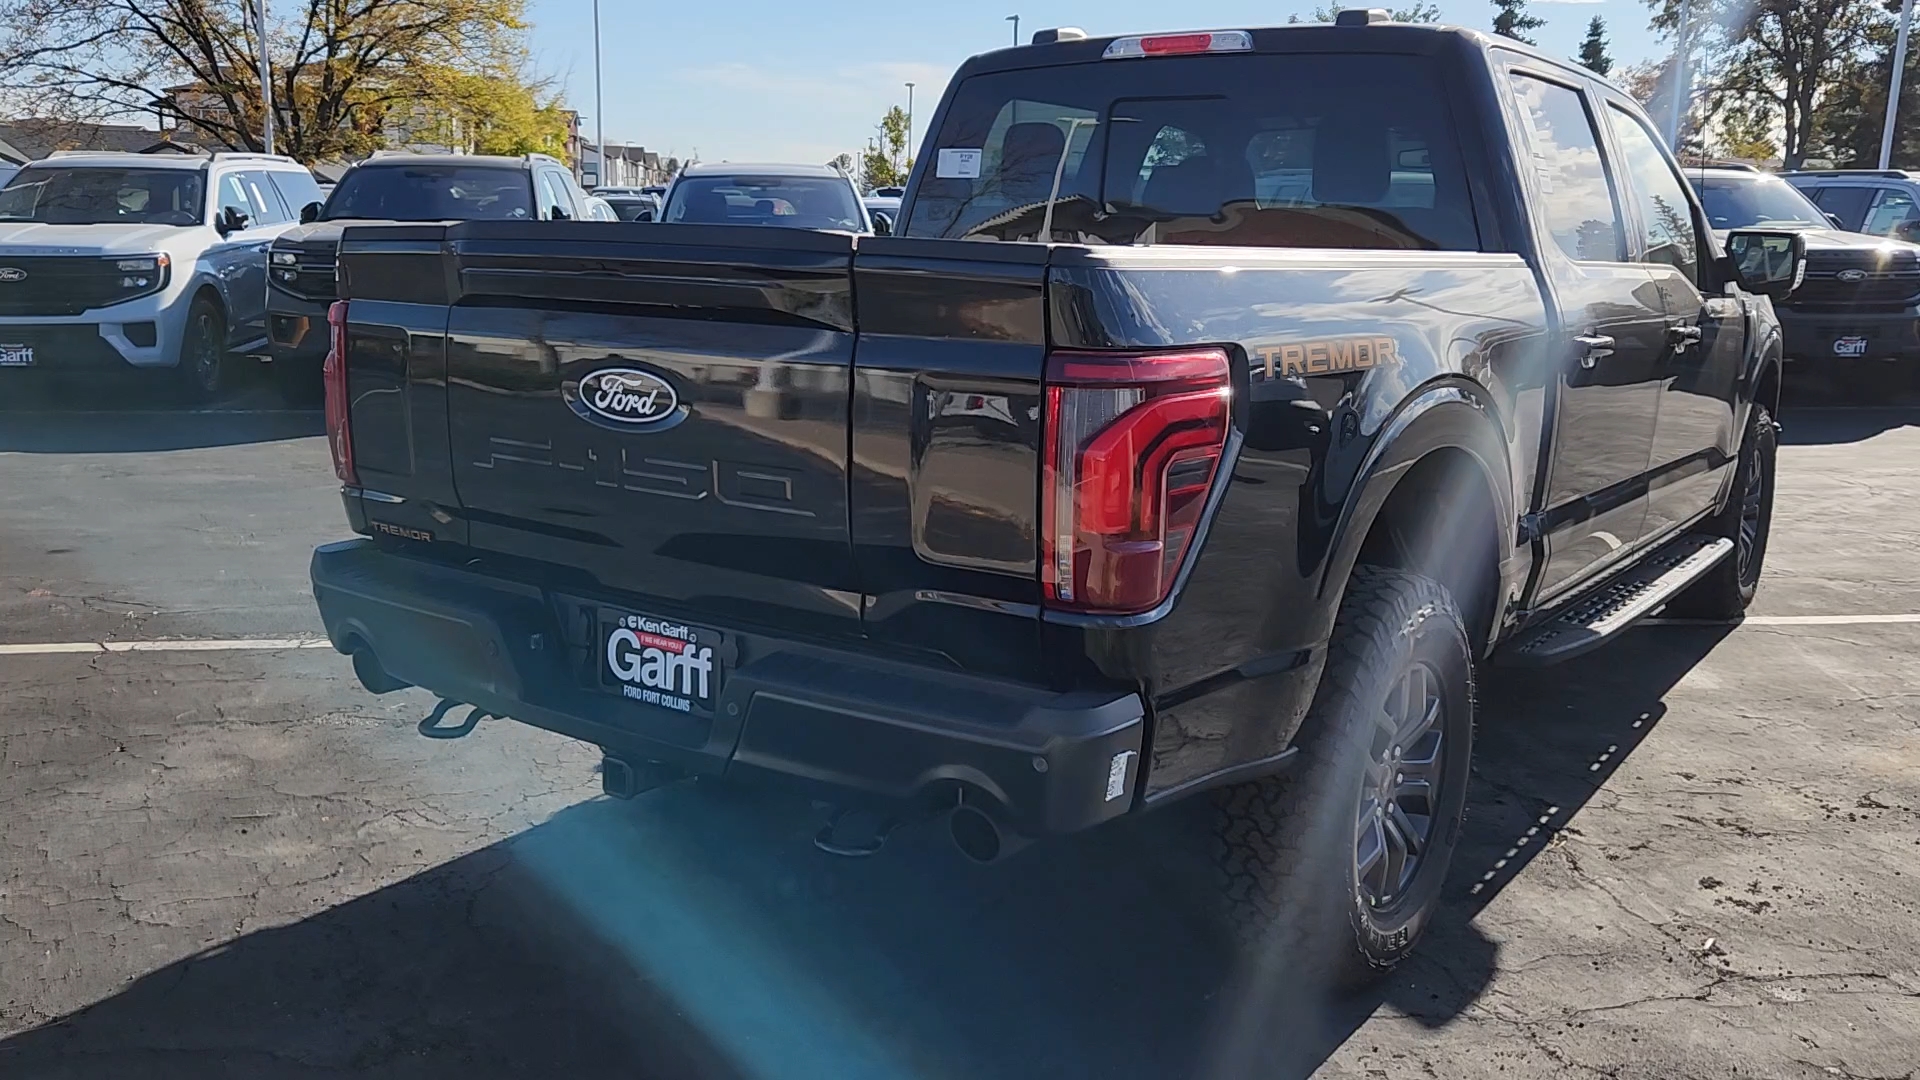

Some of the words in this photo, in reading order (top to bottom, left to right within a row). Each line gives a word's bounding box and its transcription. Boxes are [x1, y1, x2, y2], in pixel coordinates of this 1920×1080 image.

[1256, 337, 1401, 379] TREMOR
[1833, 340, 1868, 354] Garff
[594, 374, 658, 415] Ford
[472, 437, 817, 518] F-150
[371, 521, 432, 543] TREMOR
[637, 616, 660, 633] Ken
[660, 621, 689, 641] Garff
[653, 638, 667, 647] HEAR
[607, 628, 713, 699] Garff
[623, 684, 642, 700] FORD
[642, 689, 660, 705] FORT
[661, 693, 690, 712] COLLINS
